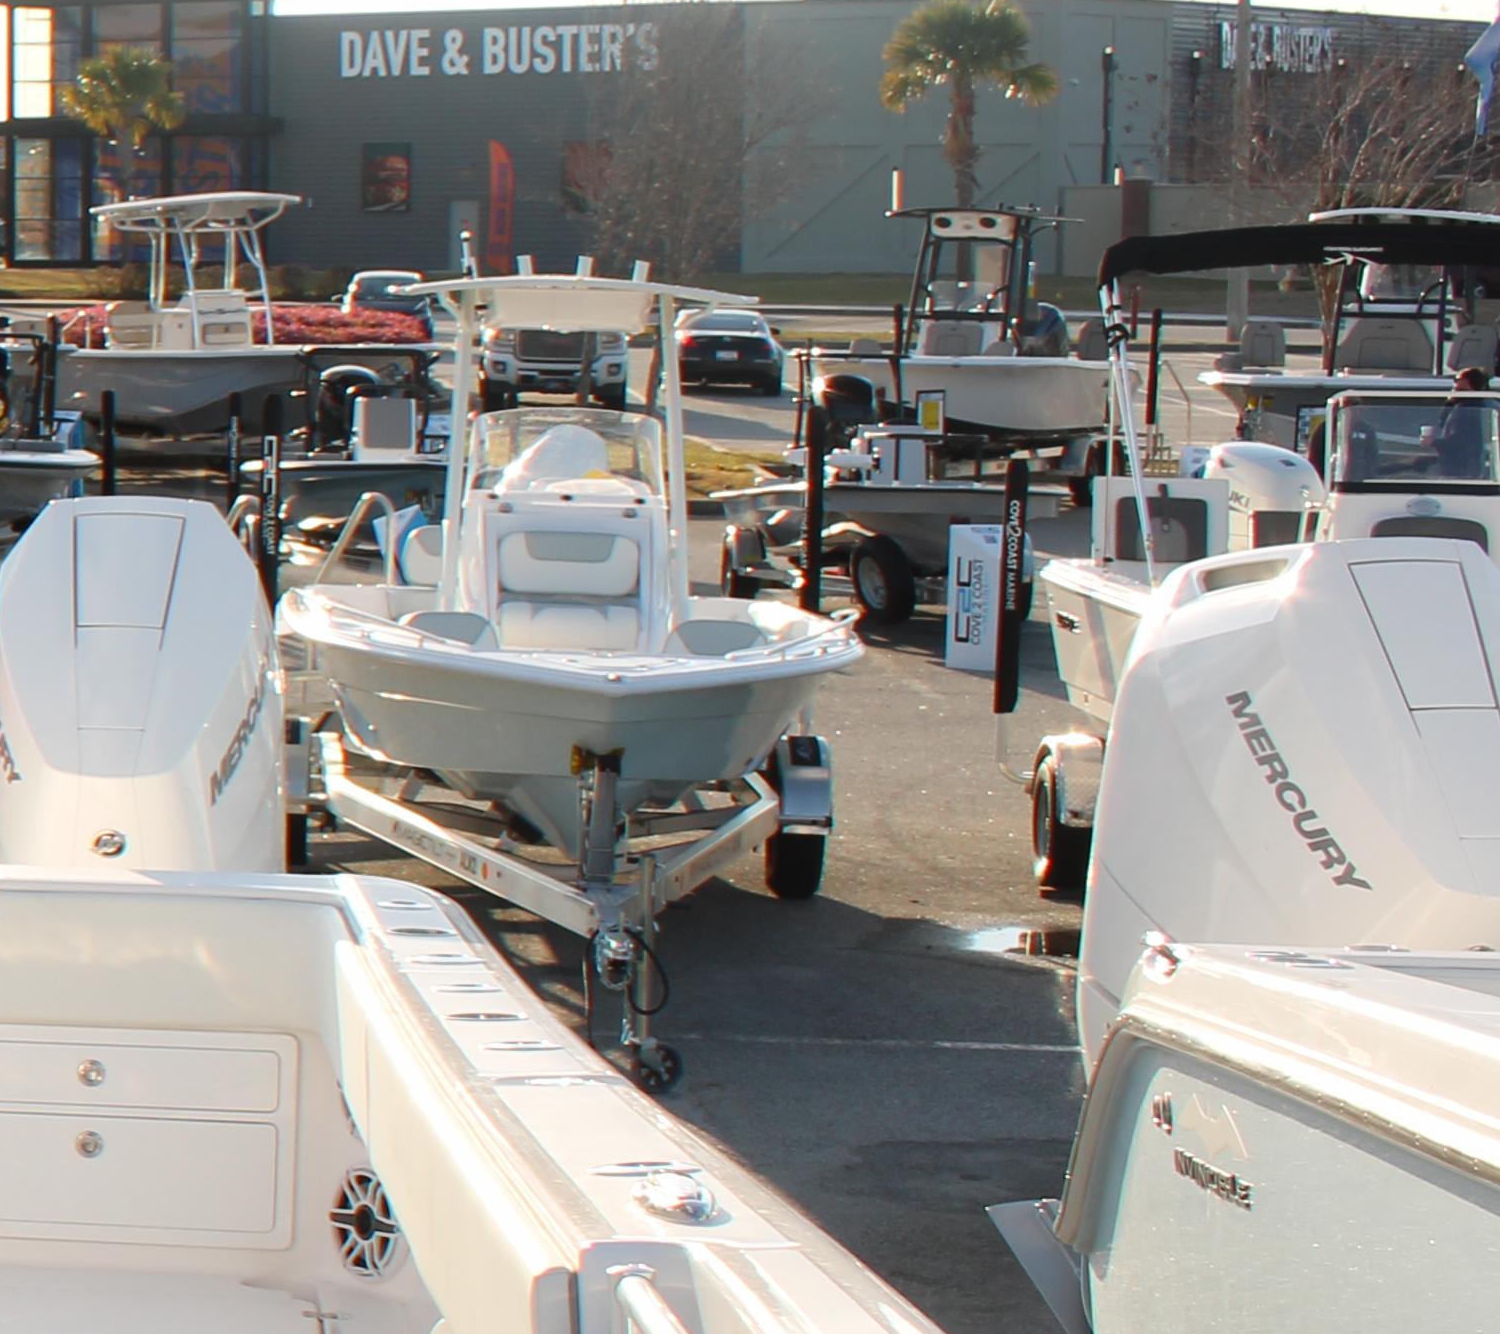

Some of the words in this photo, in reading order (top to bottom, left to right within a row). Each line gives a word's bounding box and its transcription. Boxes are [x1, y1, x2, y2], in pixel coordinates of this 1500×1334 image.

[340, 28, 430, 78] DAVE
[441, 28, 469, 75] &
[482, 22, 660, 75] BUSTER'S
[972, 558, 984, 599] COAST
[971, 612, 982, 646] COVE
[1226, 690, 1373, 890] MERCURY
